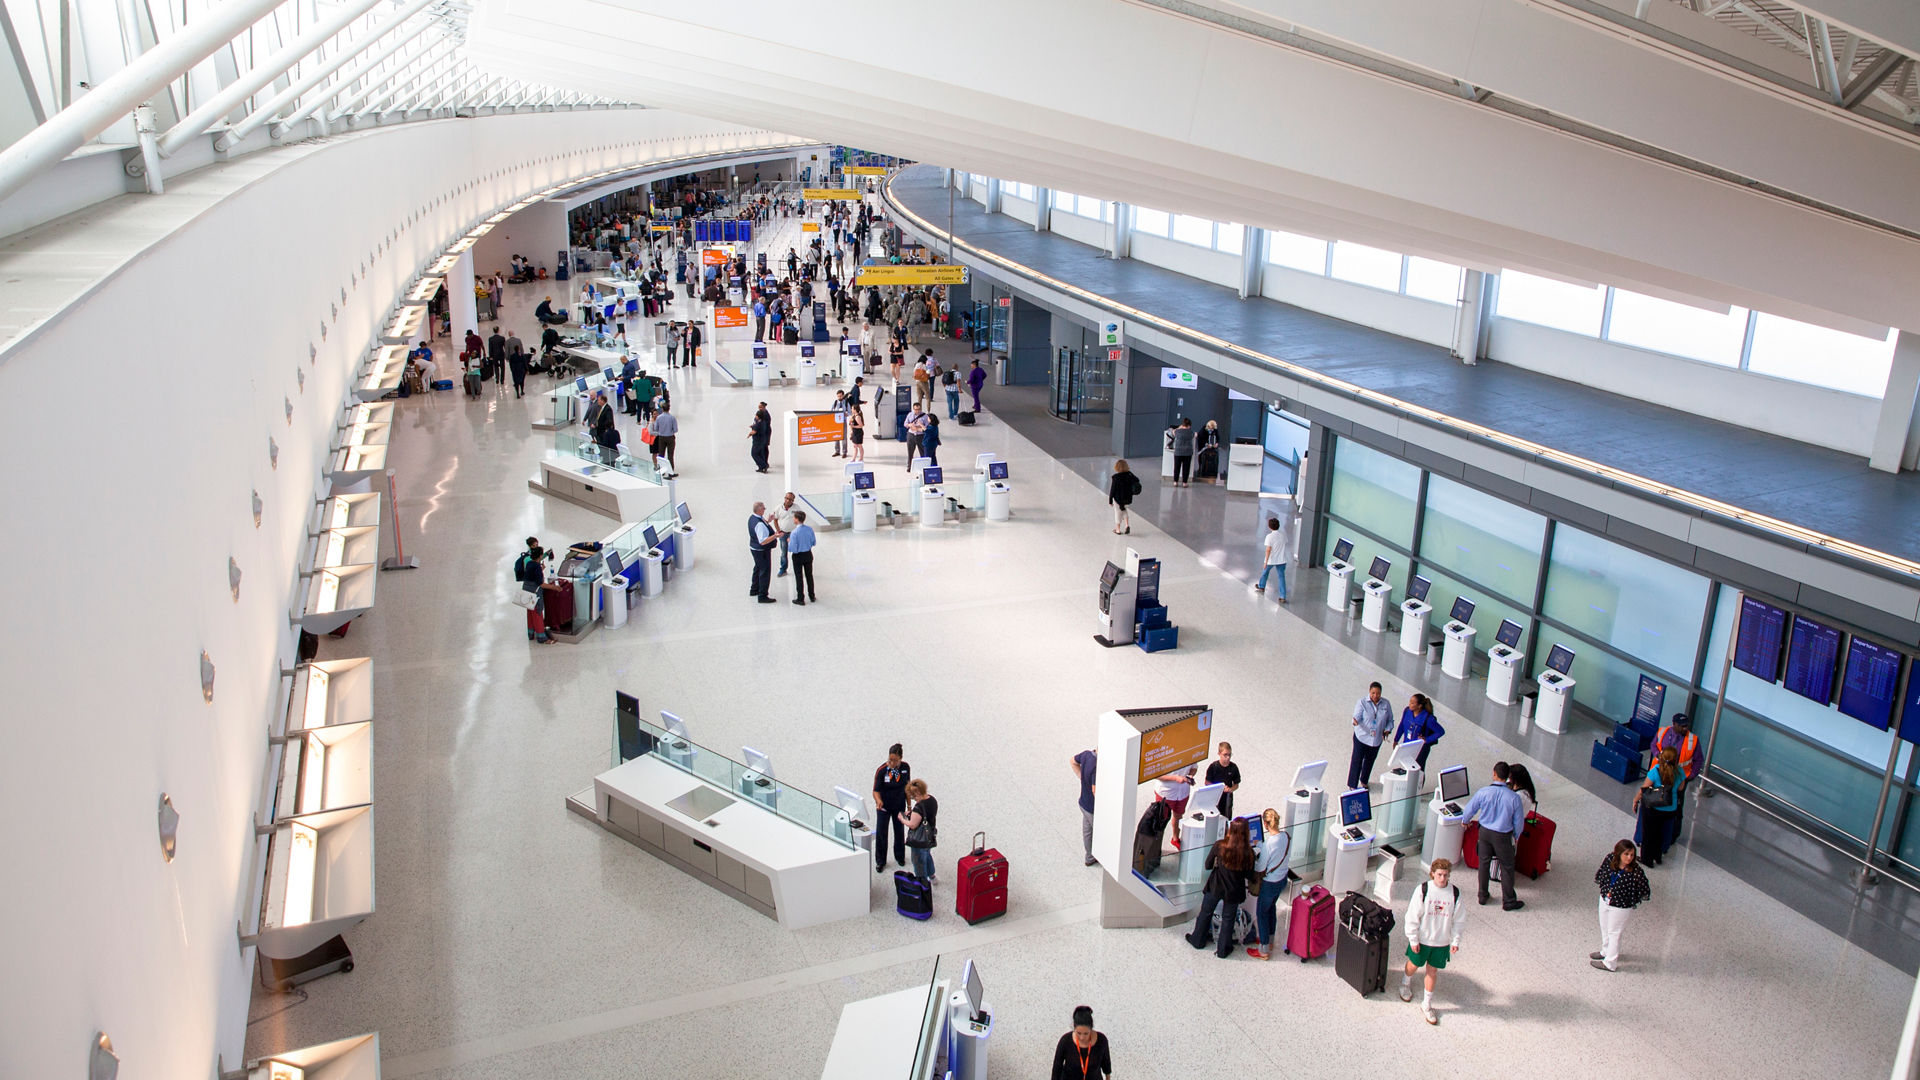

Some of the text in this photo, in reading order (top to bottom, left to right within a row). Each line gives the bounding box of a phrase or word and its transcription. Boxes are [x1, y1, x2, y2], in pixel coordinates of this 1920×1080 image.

[1110, 350, 1121, 360] EXIT
[1744, 598, 1766, 610] Departures
[1796, 617, 1819, 630] Departures
[1853, 638, 1878, 652] Departures
